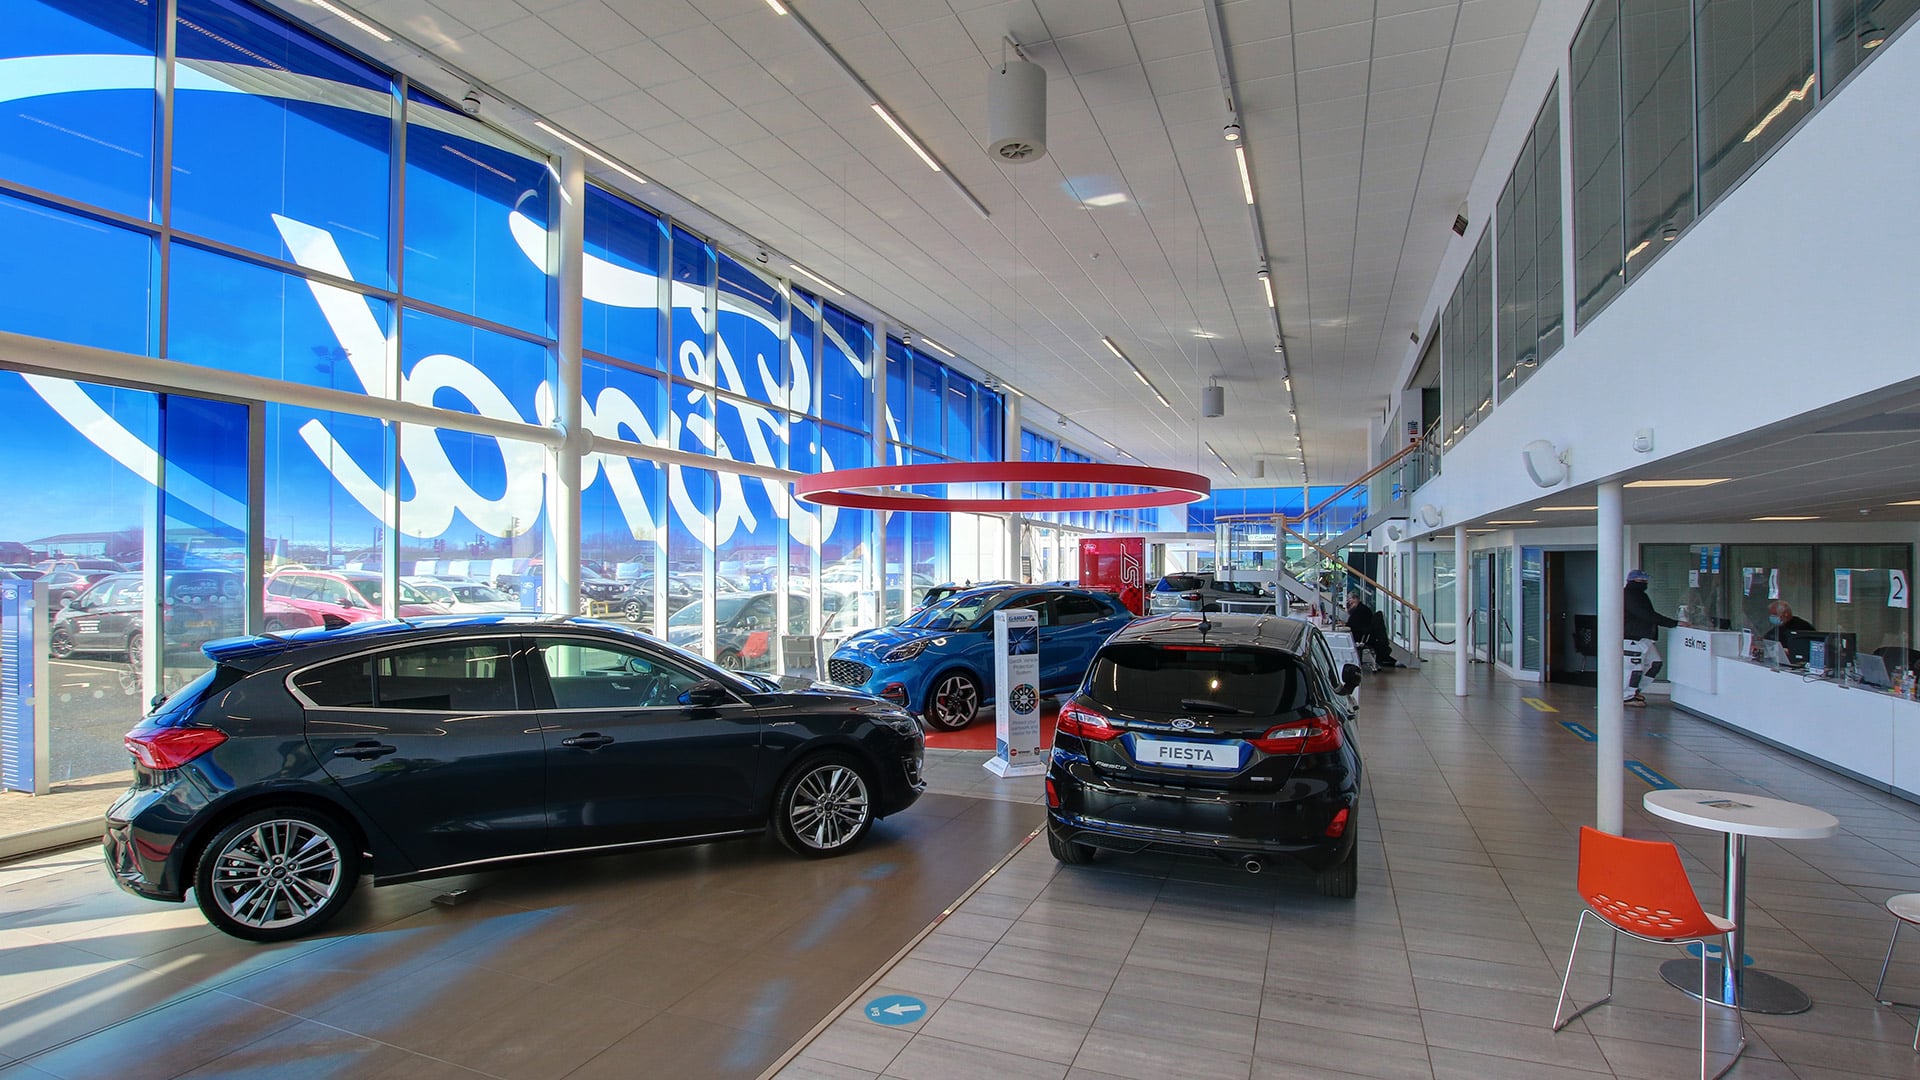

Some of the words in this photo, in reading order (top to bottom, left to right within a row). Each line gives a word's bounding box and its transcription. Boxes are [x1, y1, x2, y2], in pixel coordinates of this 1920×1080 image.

[1120, 543, 1140, 589] ST
[1892, 575, 1904, 600] 2
[1684, 636, 1696, 649] ask
[1696, 639, 1707, 651] me
[1159, 746, 1214, 762] FIESTA
[1095, 760, 1127, 771] Fiesta
